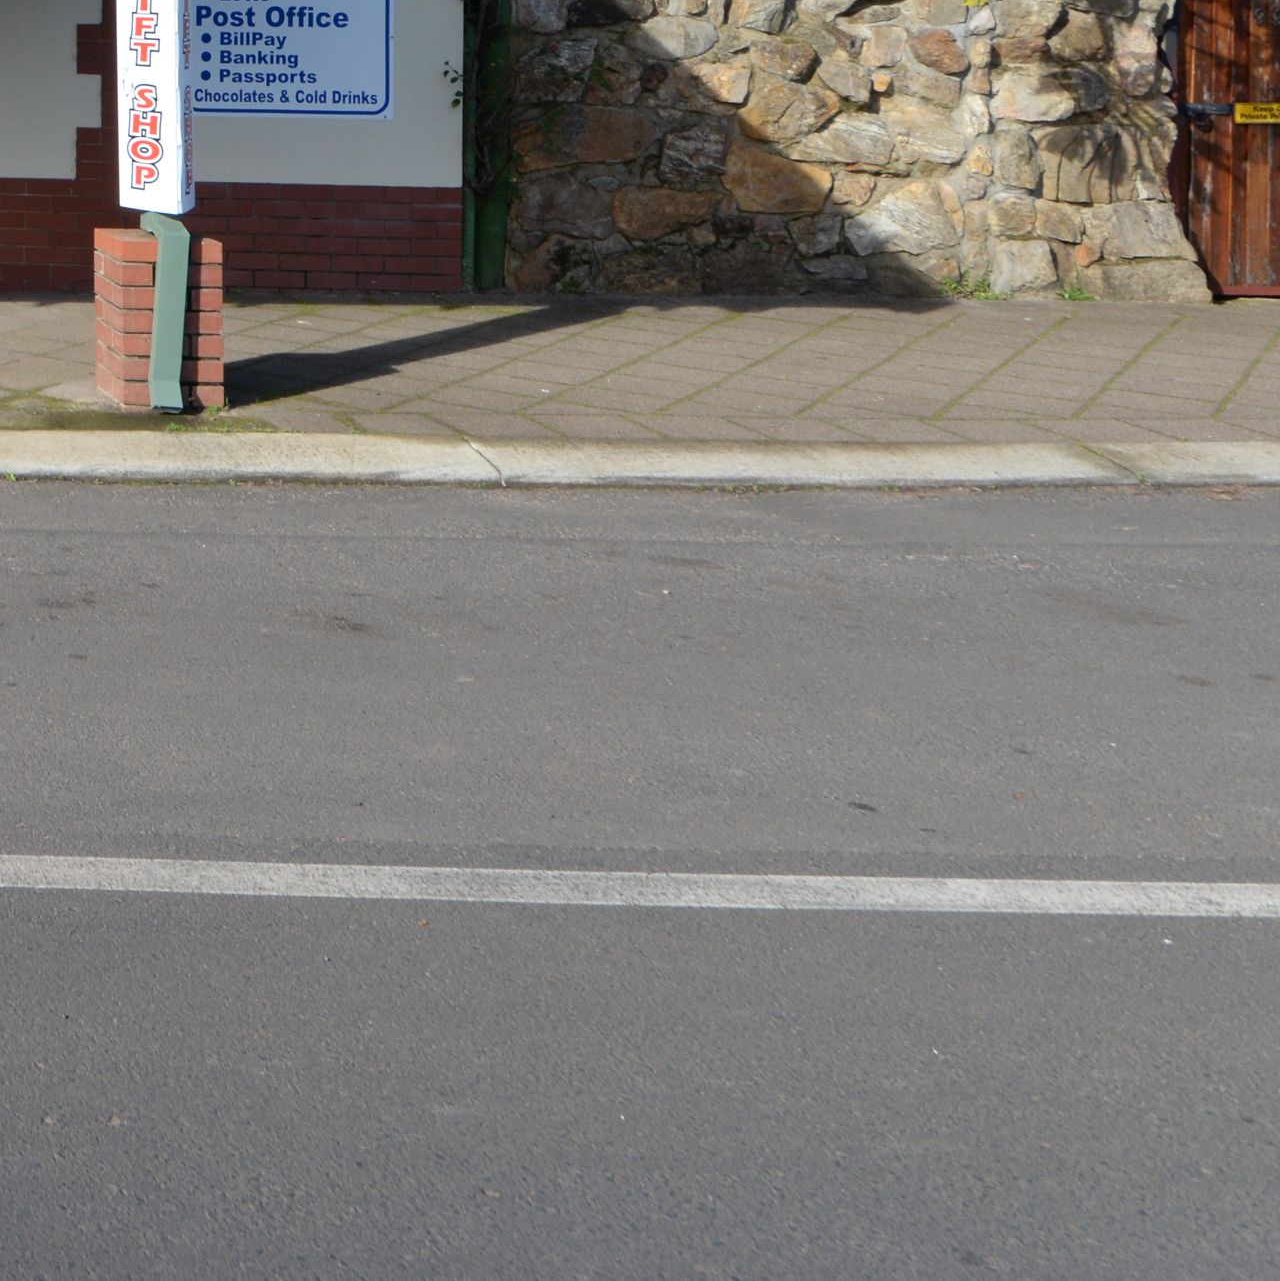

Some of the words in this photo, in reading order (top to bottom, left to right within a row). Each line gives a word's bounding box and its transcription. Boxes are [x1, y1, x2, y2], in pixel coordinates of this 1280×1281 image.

[195, 5, 256, 27] Post
[265, 6, 349, 28] Office
[219, 31, 287, 50] BillPay
[219, 50, 299, 68] Banking
[219, 69, 317, 86] Passports
[194, 88, 274, 103] Chocolates
[280, 90, 290, 103] &
[295, 90, 327, 104] Cold
[332, 90, 378, 105] Drinks
[127, 83, 164, 190] SHOP
